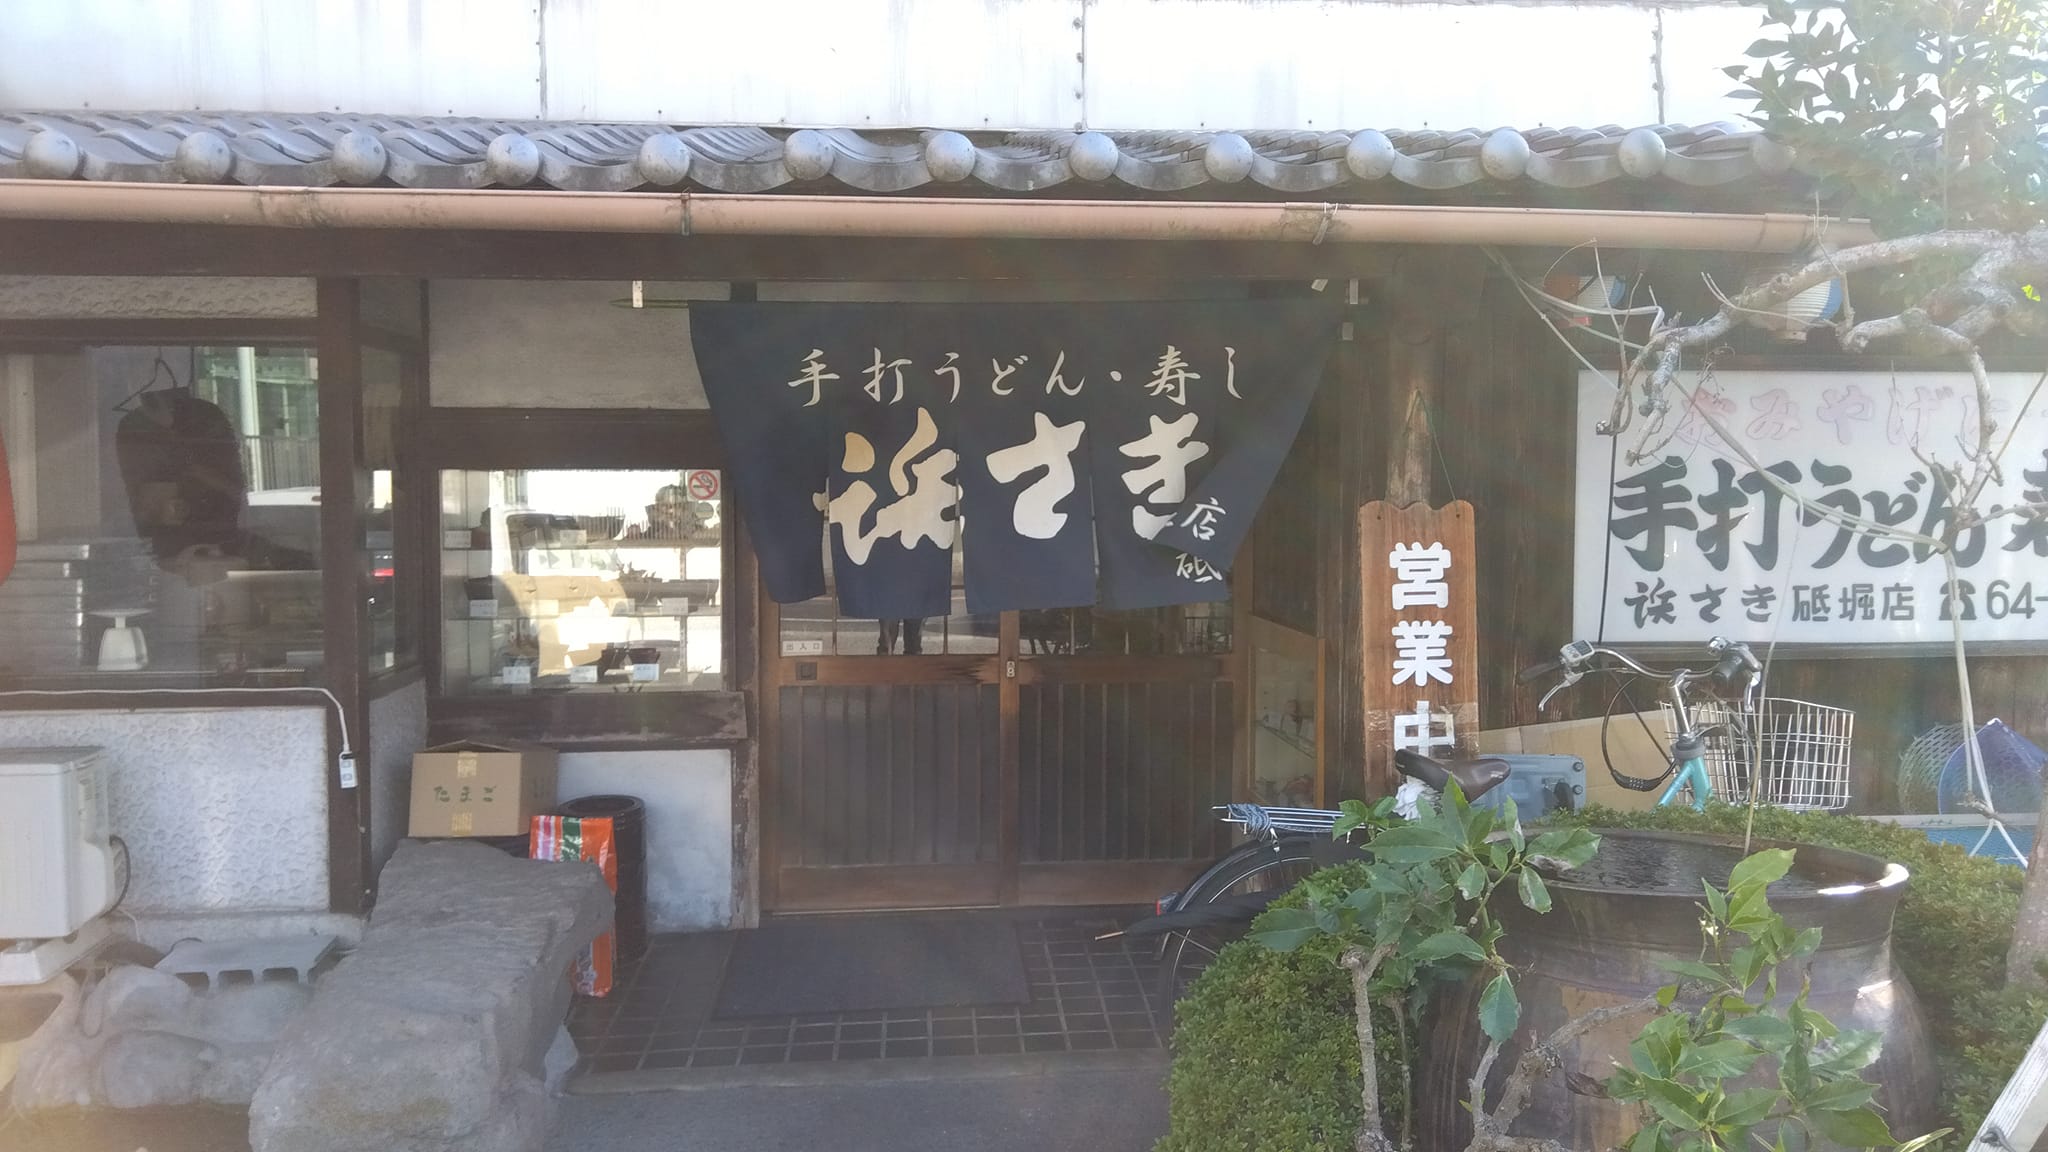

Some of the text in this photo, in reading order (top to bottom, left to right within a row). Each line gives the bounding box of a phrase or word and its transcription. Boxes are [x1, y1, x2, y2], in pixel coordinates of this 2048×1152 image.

[787, 345, 1242, 406] 手打うどん・寿し
[1389, 541, 1455, 757] 営業中
